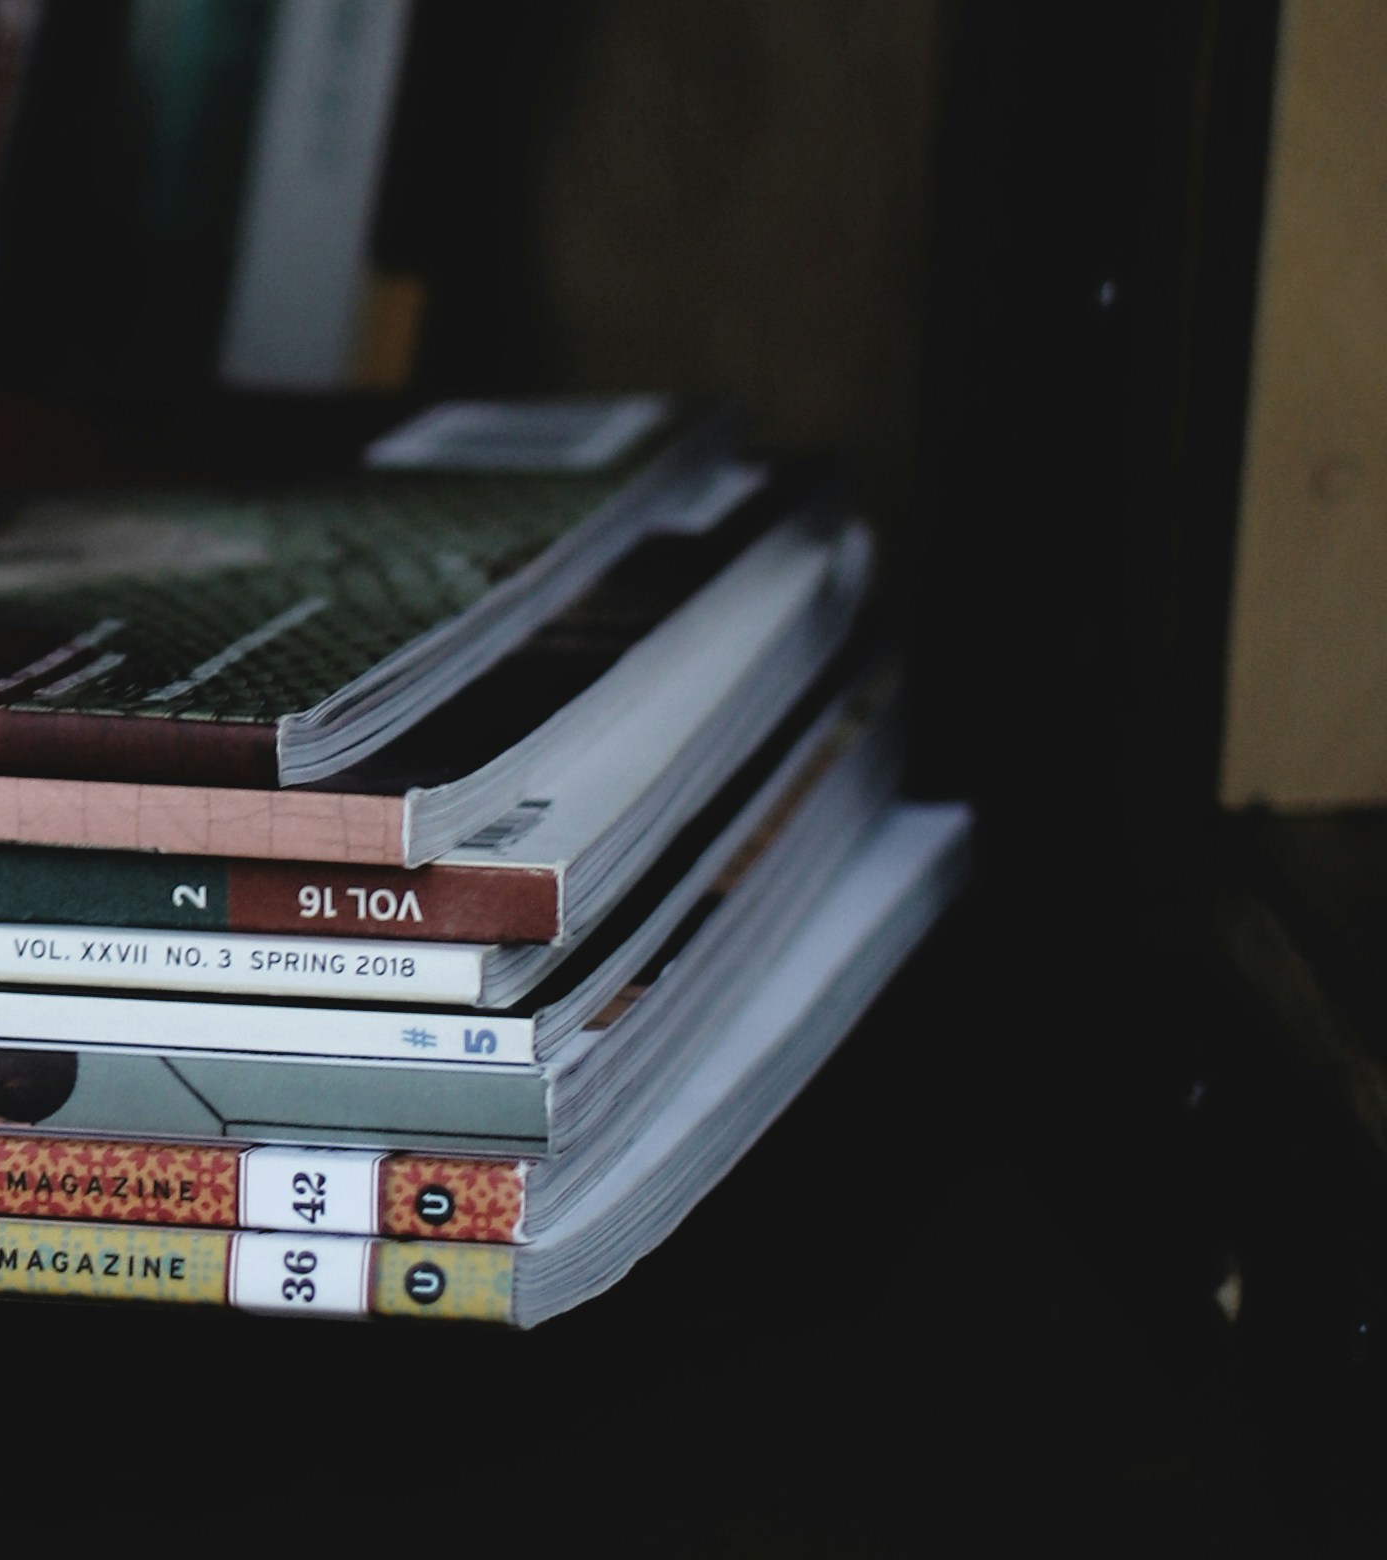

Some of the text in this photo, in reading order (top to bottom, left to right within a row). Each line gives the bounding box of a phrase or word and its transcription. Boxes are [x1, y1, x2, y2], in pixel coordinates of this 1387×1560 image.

[297, 884, 425, 923] VOL 16
[14, 937, 417, 979] VOL. XXVII NO. 3 SPRING 2018
[7, 1170, 197, 1202] MAGAZINE
[291, 1170, 327, 1225] 42
[282, 1249, 318, 1305] 36
